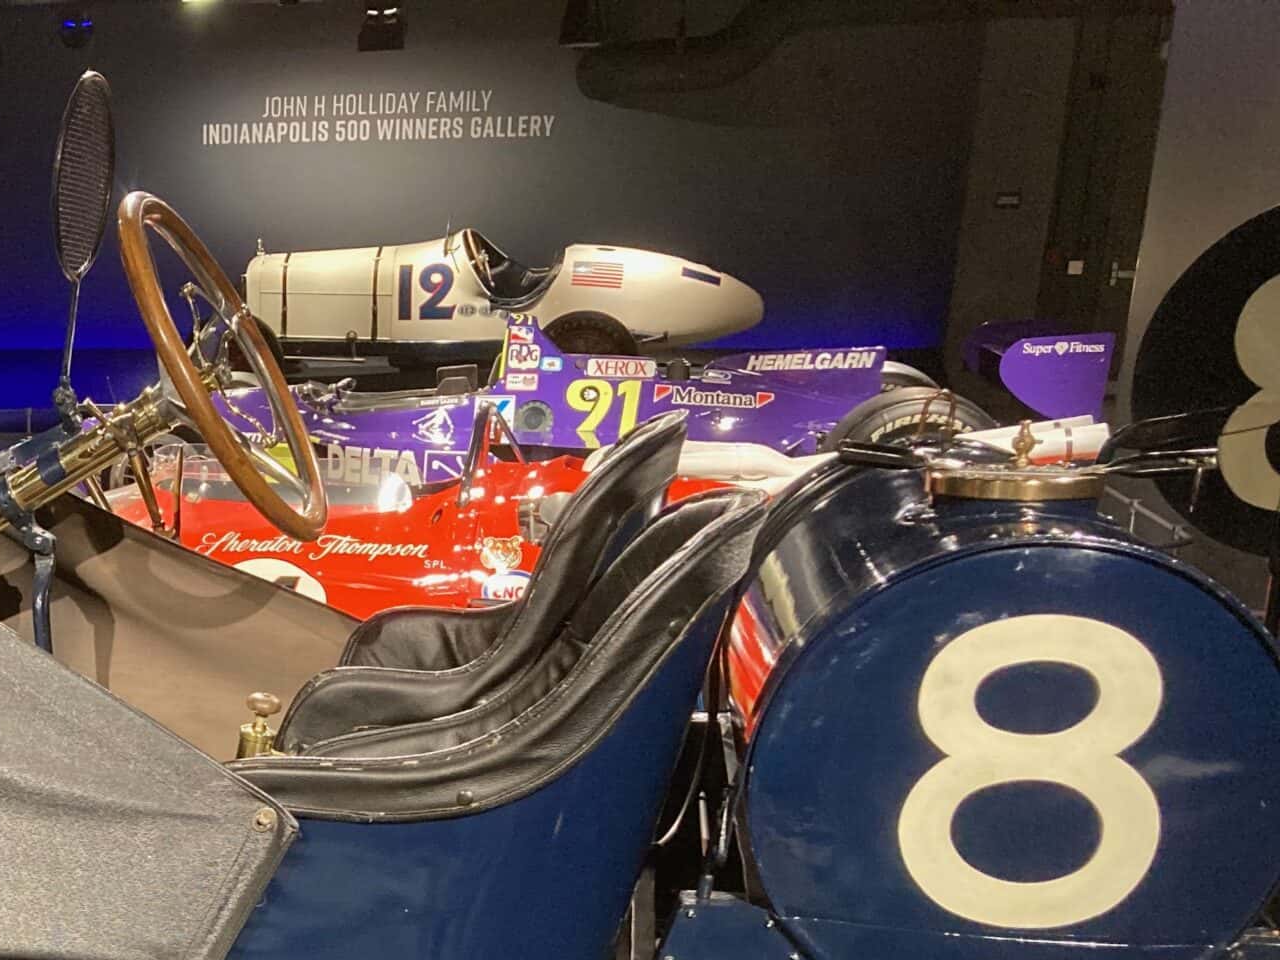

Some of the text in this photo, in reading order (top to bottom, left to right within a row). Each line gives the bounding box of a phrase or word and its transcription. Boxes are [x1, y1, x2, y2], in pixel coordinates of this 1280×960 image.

[262, 89, 493, 118] JOHN H HOLLIDAY FAMILY
[202, 114, 556, 146] INDIANAPOLIS 500 WINNERS GALLERY
[397, 263, 457, 321] 12
[746, 351, 877, 371] HEMELGARN
[1022, 341, 1105, 357] Super Fitness
[594, 359, 649, 376] XEROX
[566, 379, 642, 440] 91
[672, 386, 755, 408] Montana
[326, 443, 421, 488] DELTA
[195, 531, 430, 562] Sheraton Thompson
[898, 613, 1163, 929] 8
